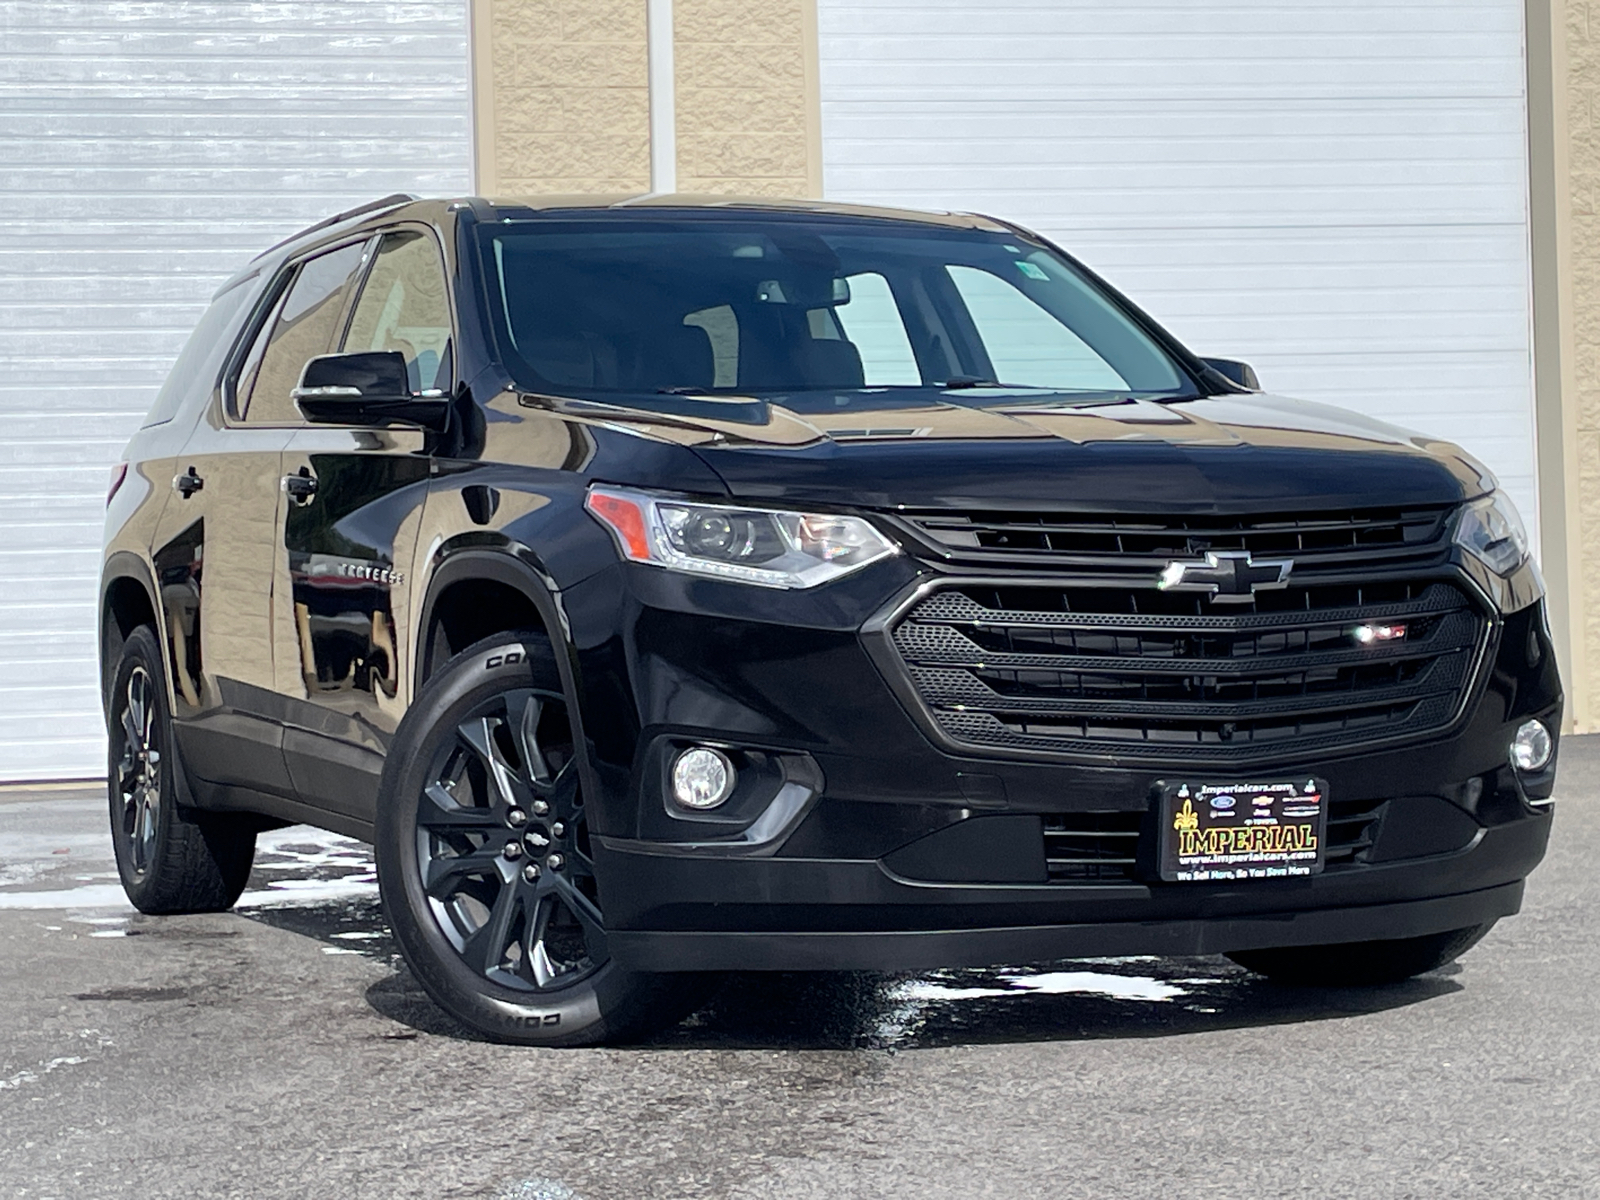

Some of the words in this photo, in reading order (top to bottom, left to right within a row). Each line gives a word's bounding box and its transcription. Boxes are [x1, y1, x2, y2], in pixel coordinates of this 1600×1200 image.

[338, 563, 404, 585] TRAVERSE
[1179, 825, 1317, 856] IMPERIAL
[1179, 852, 1316, 865] www.imperialcars.com
[1177, 871, 1192, 880] We
[1193, 871, 1209, 880] Sell
[1211, 870, 1235, 880] More,
[1236, 869, 1248, 878] So
[1249, 868, 1265, 877] You
[1267, 867, 1287, 876] Save
[1288, 866, 1310, 875] More
